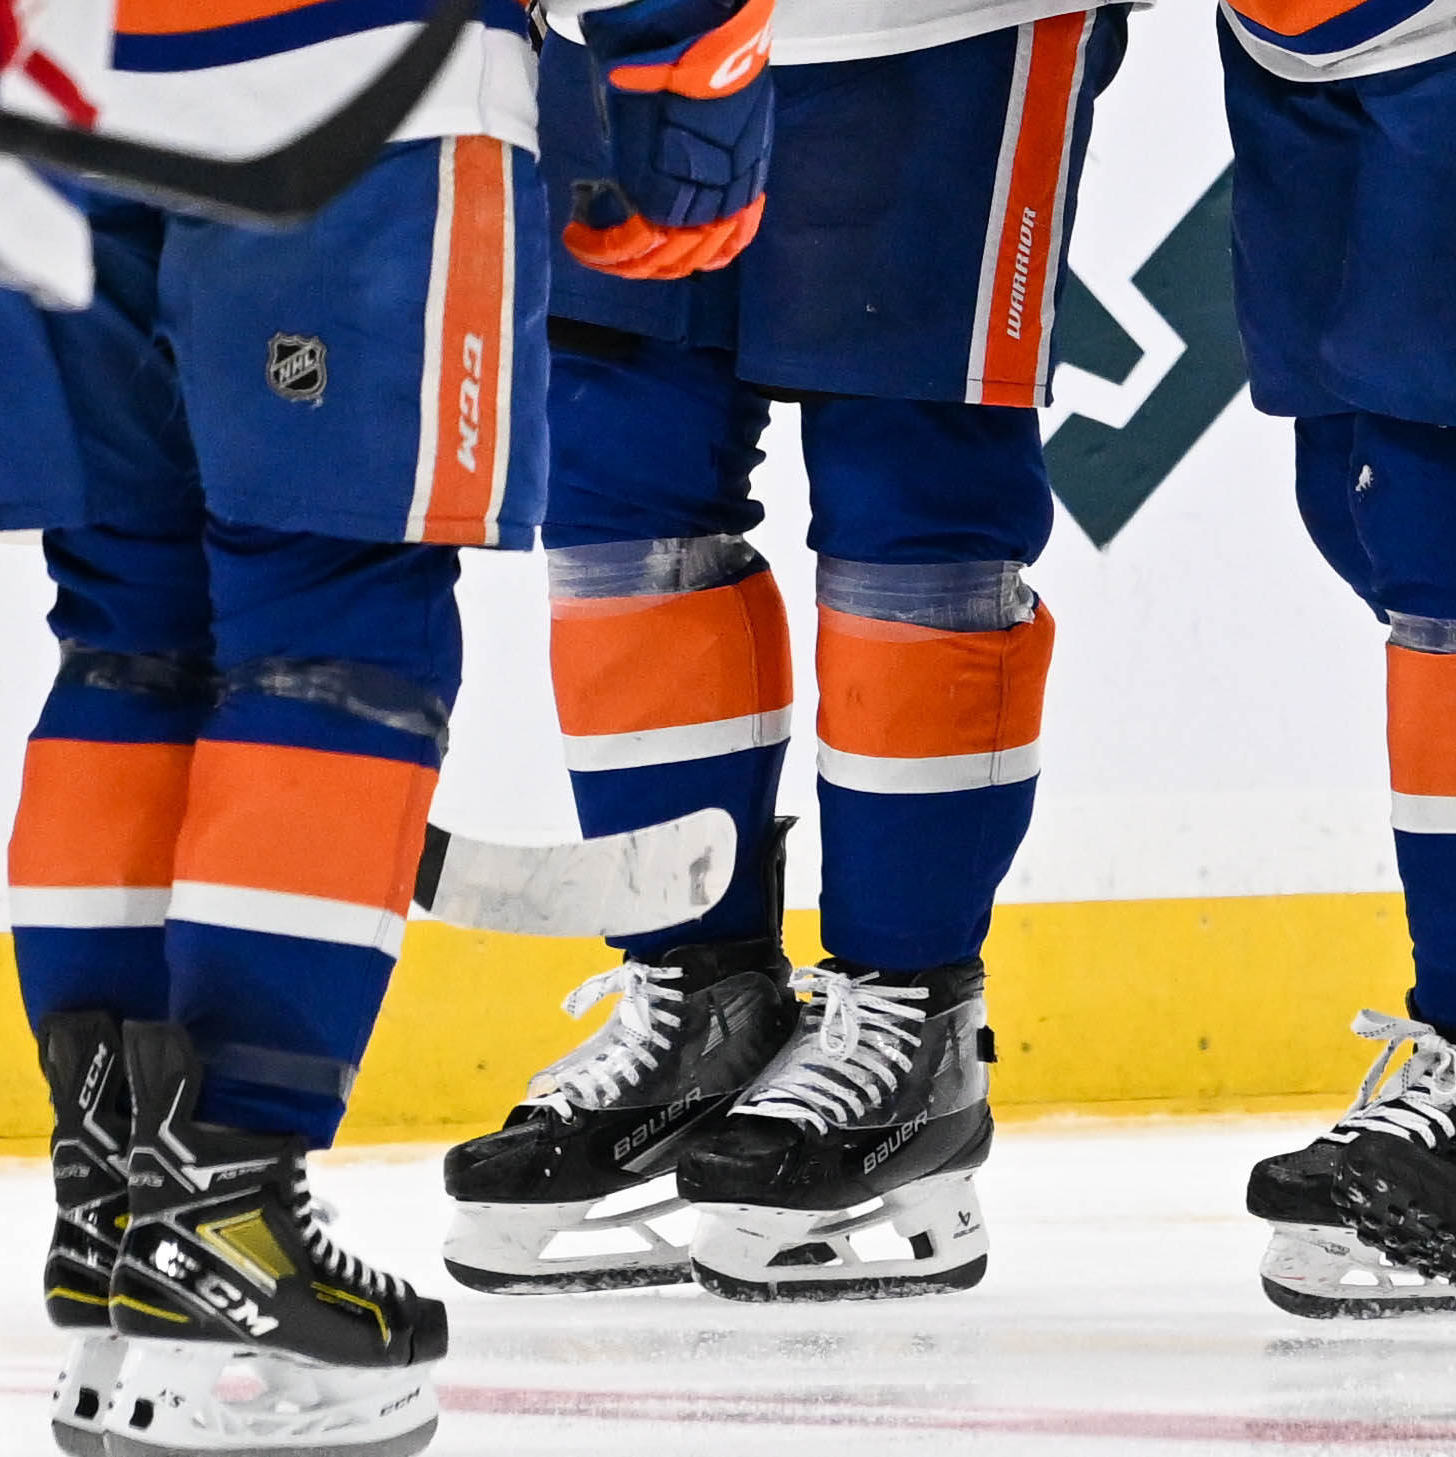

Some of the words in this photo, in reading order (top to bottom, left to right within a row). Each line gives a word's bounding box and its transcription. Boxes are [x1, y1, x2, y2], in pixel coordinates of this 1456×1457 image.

[1006, 205, 1036, 341] WARRIOR
[278, 350, 317, 384] NHL
[456, 332, 484, 473] CCM
[78, 1041, 108, 1110] CCM
[613, 1085, 703, 1162] BAUER
[863, 1109, 930, 1176] BAUER
[149, 1240, 280, 1338] CM
[378, 1386, 422, 1418] CCM
